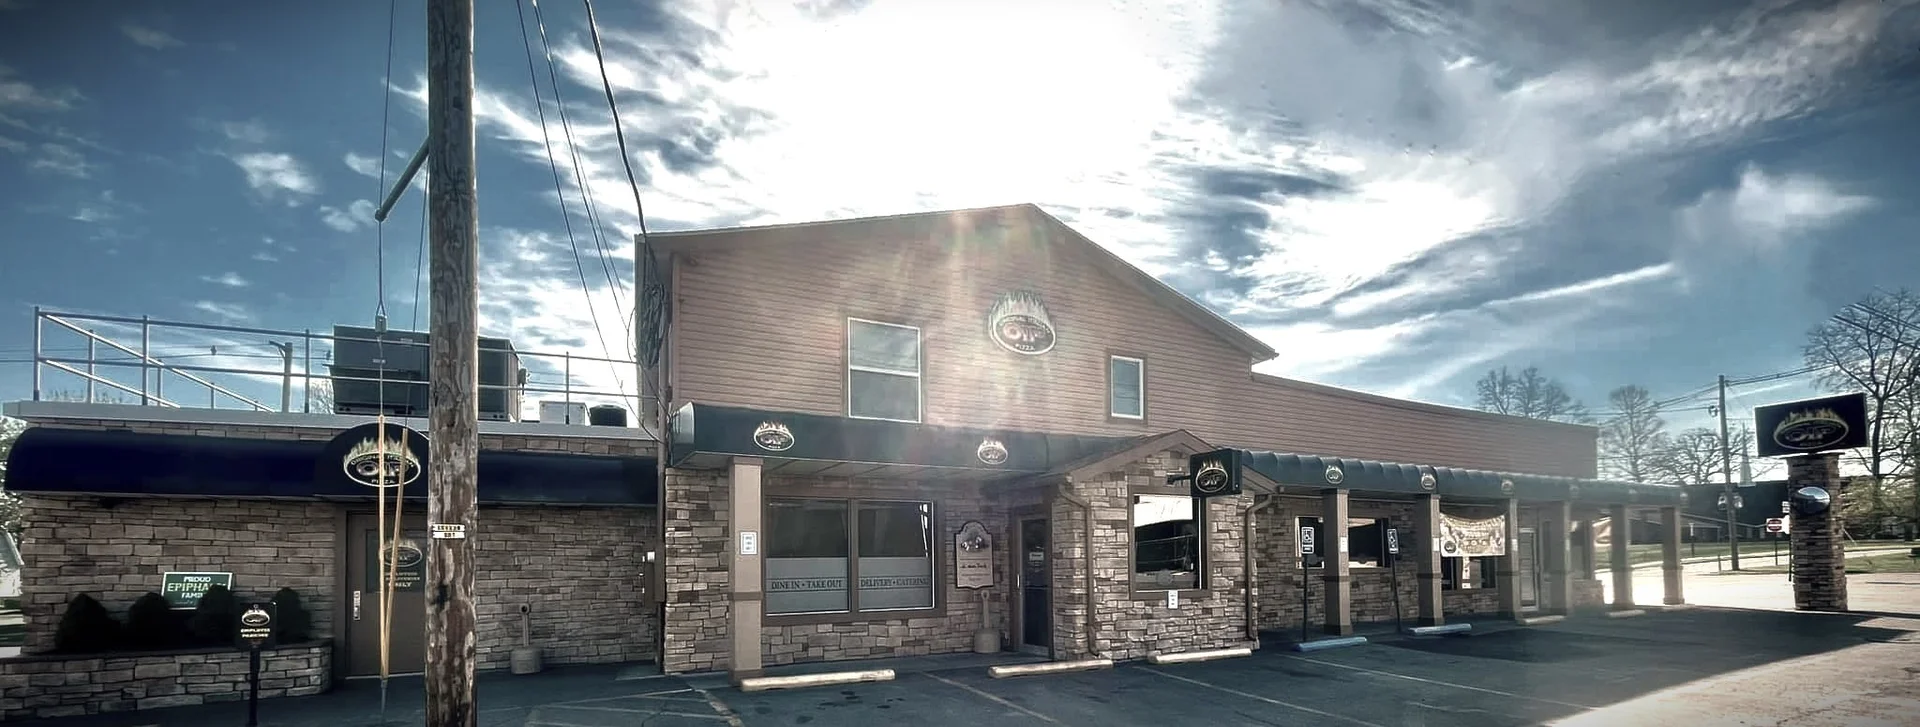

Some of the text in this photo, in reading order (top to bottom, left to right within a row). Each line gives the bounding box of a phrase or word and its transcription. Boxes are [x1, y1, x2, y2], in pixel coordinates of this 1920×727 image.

[167, 582, 227, 592] EPIPHA
[771, 579, 842, 590] DINE IN TAKE OUT
[860, 578, 893, 587] DELIVERY
